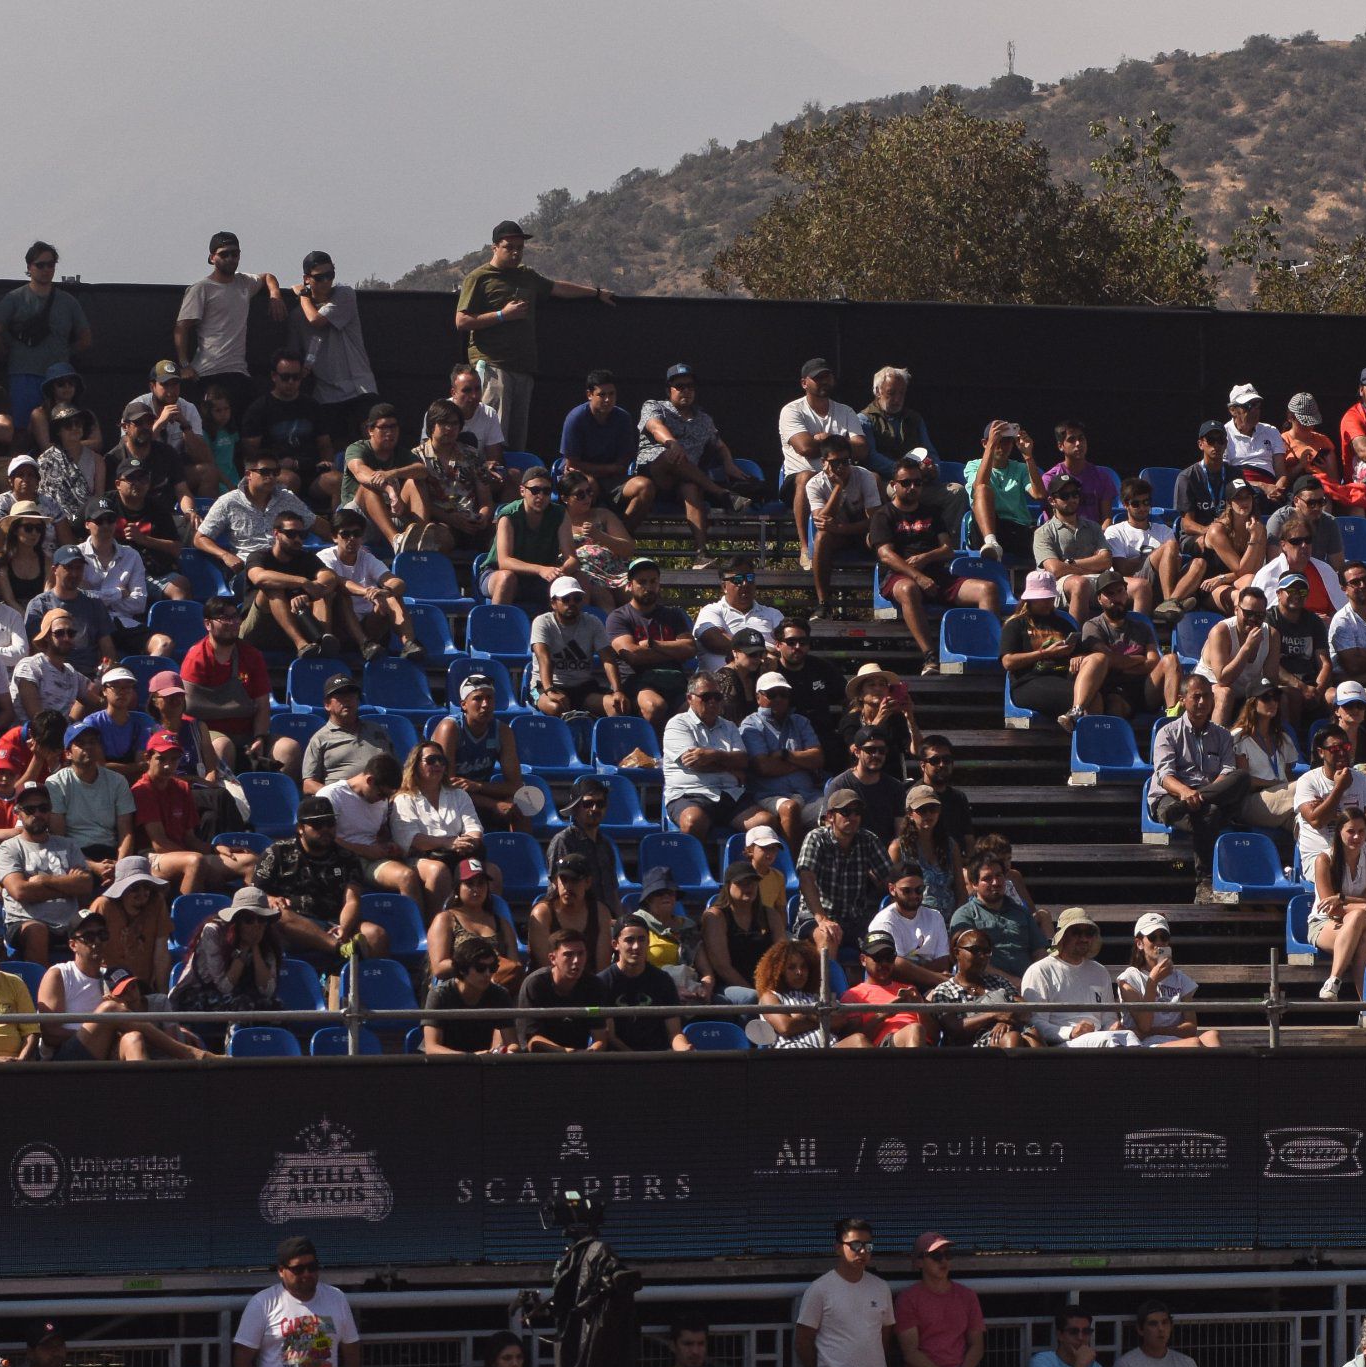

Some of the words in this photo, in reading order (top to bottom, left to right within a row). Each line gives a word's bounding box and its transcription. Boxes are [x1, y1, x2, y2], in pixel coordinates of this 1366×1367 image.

[69, 1155, 182, 1174] Universidad
[287, 1167, 365, 1184] STELLA
[285, 1187, 367, 1205] ARTOIS
[457, 1174, 692, 1203] SCALPERS
